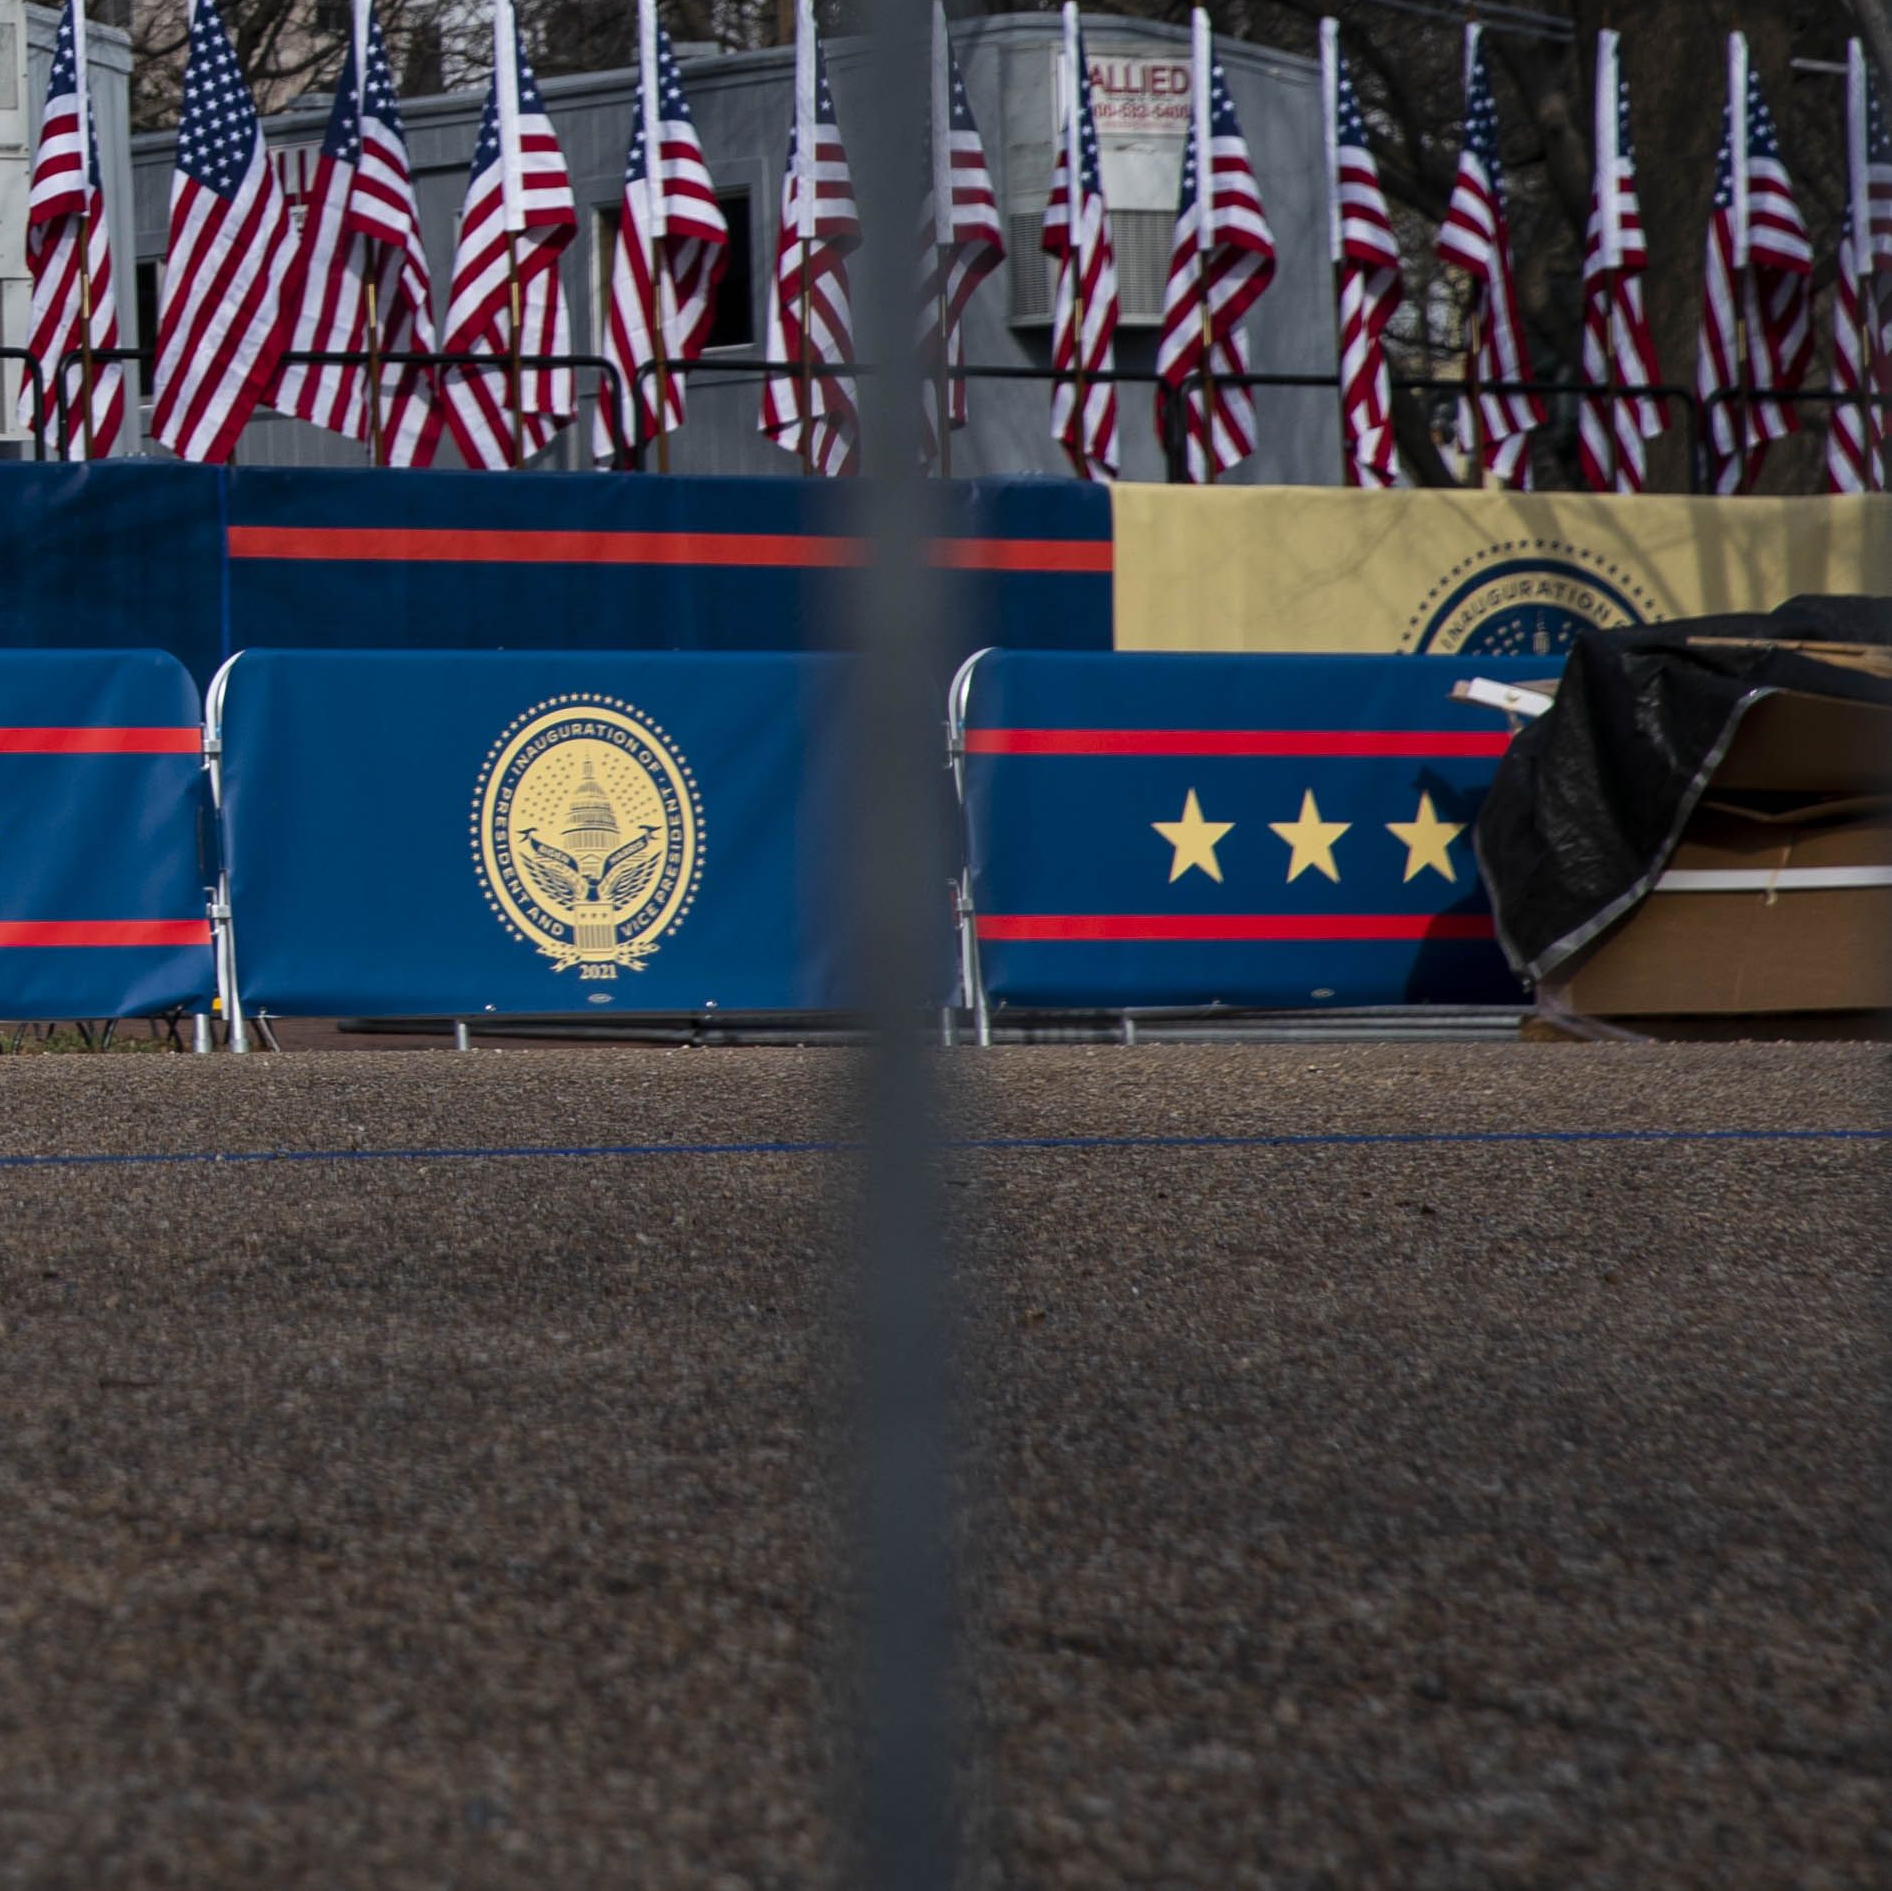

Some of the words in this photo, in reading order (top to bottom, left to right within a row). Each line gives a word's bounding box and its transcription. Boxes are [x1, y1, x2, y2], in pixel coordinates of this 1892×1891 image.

[1090, 64, 1190, 95] ALLIED
[1440, 579, 1613, 650] INAUGURATION
[511, 723, 638, 775] INAUGURATION
[638, 749, 662, 773] OF
[495, 786, 530, 904] PRESIDENT
[526, 906, 564, 936] AND
[620, 902, 659, 937] VICE
[654, 787, 682, 904] PRESIDENT
[579, 963, 618, 980] 2021
